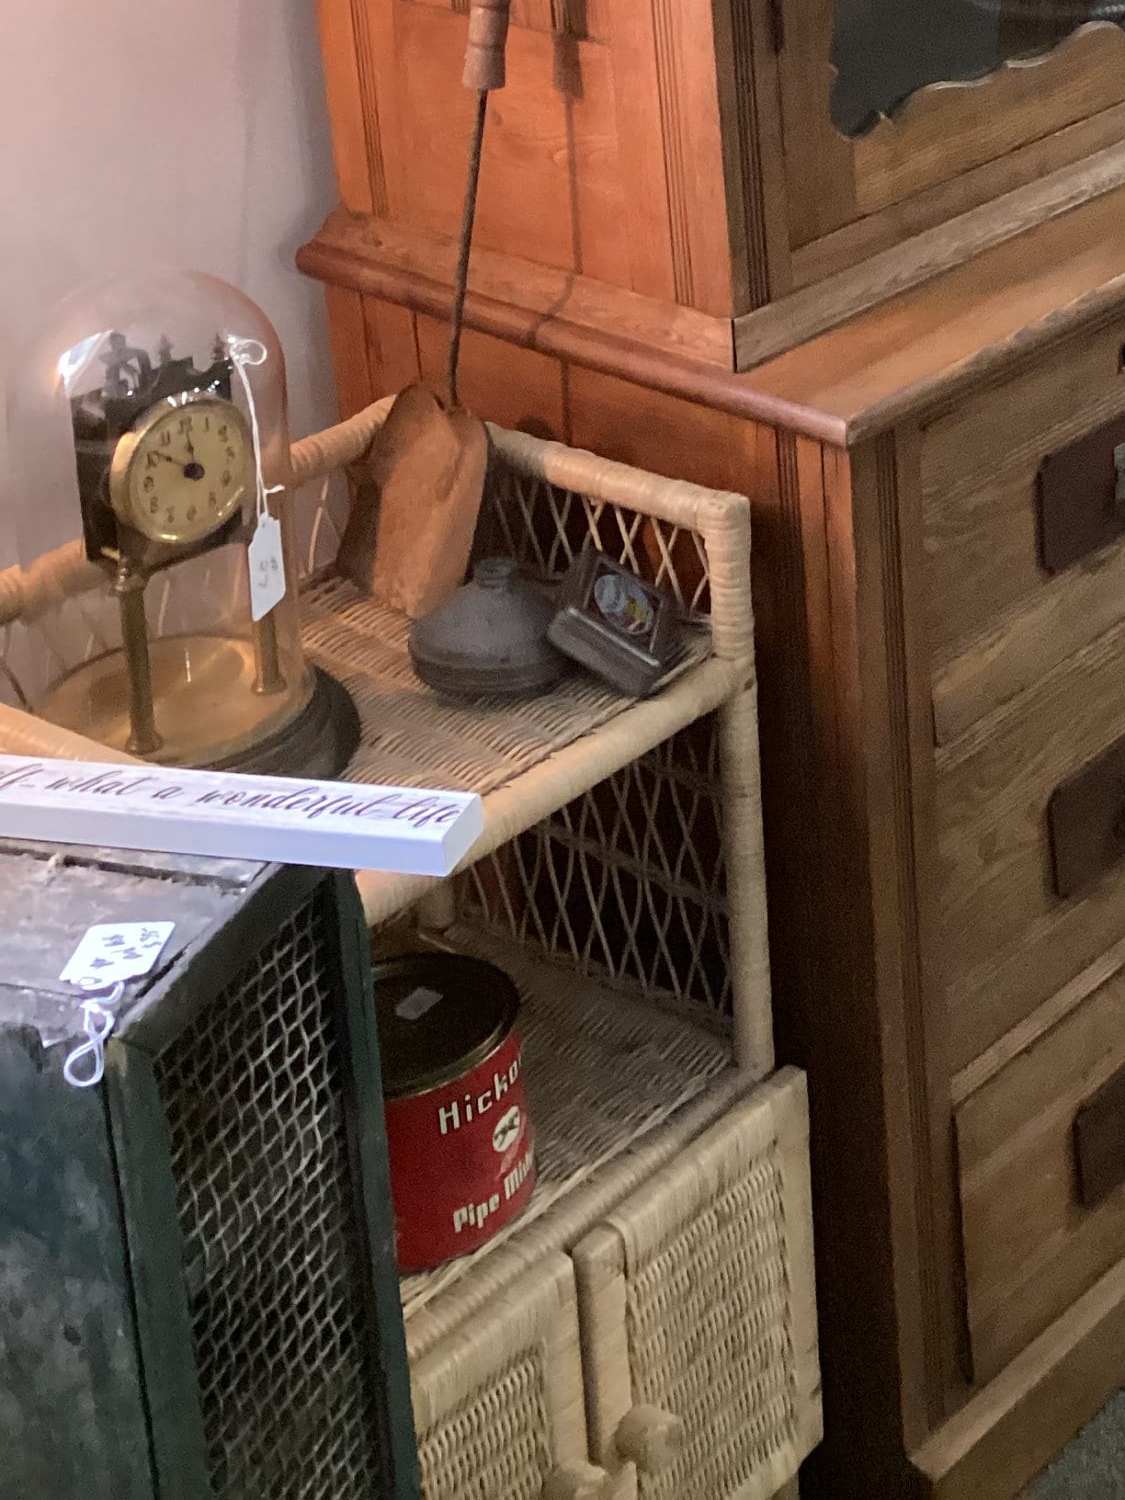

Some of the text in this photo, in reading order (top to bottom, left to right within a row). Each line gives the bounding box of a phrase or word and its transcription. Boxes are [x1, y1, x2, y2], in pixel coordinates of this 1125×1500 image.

[45, 768, 160, 796] what
[151, 785, 184, 800] a
[195, 786, 402, 819] wonderful
[392, 795, 461, 828] life
[438, 1053, 521, 1135] Hicko
[453, 1192, 500, 1234] Pipe
